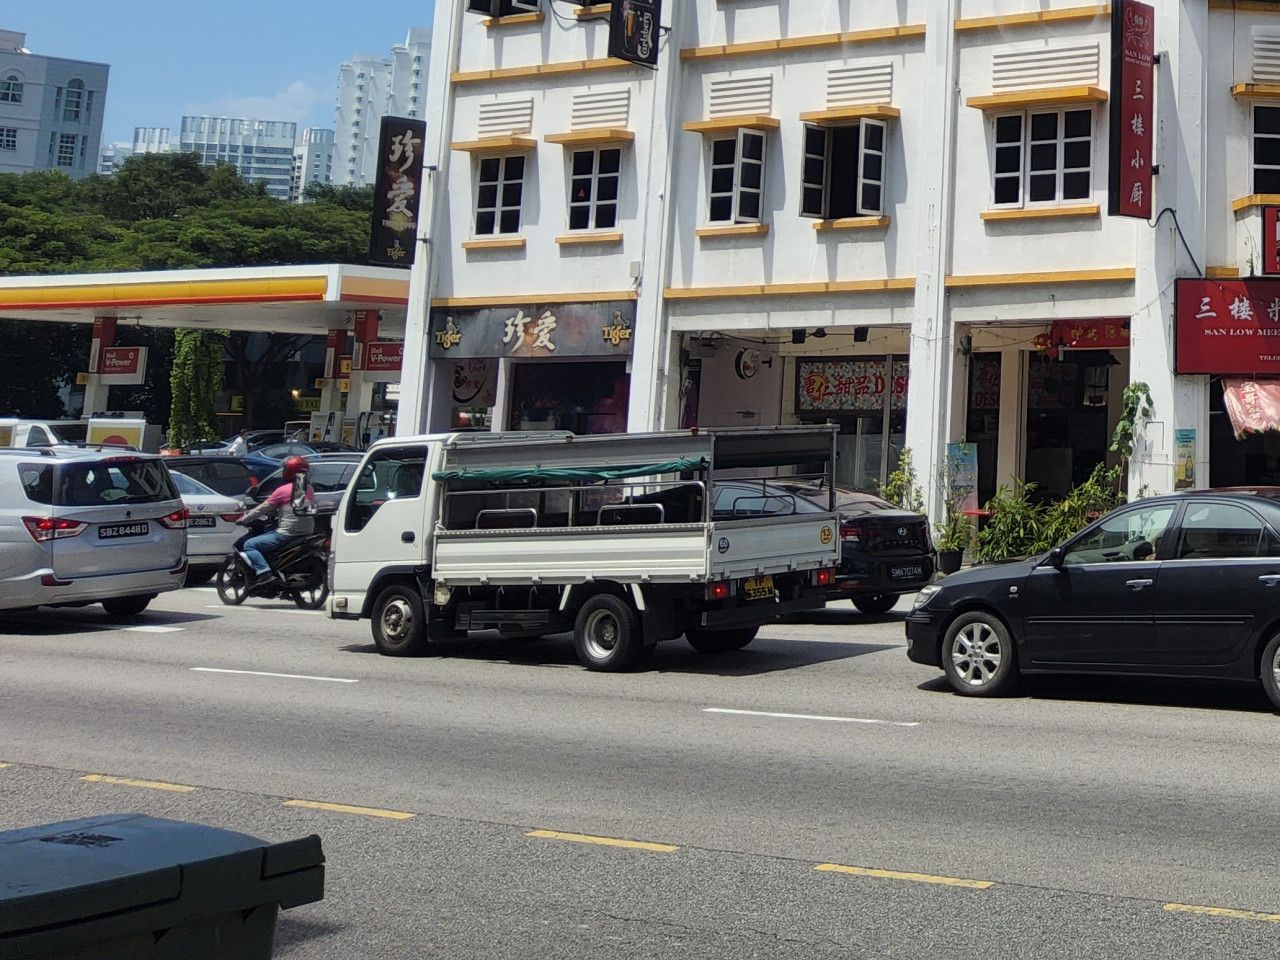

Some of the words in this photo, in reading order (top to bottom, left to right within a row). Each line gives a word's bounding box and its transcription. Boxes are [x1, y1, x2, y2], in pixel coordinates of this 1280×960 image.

[637, 10, 652, 59] Carlsberg
[386, 246, 406, 260] Tiger
[602, 325, 632, 346] Tiger
[1229, 328, 1254, 336] LOW
[435, 330, 462, 349] Tiger
[106, 358, 132, 367] V-Power
[370, 354, 401, 363] V-Power
[821, 528, 831, 538] 13
[719, 539, 729, 548] 60
